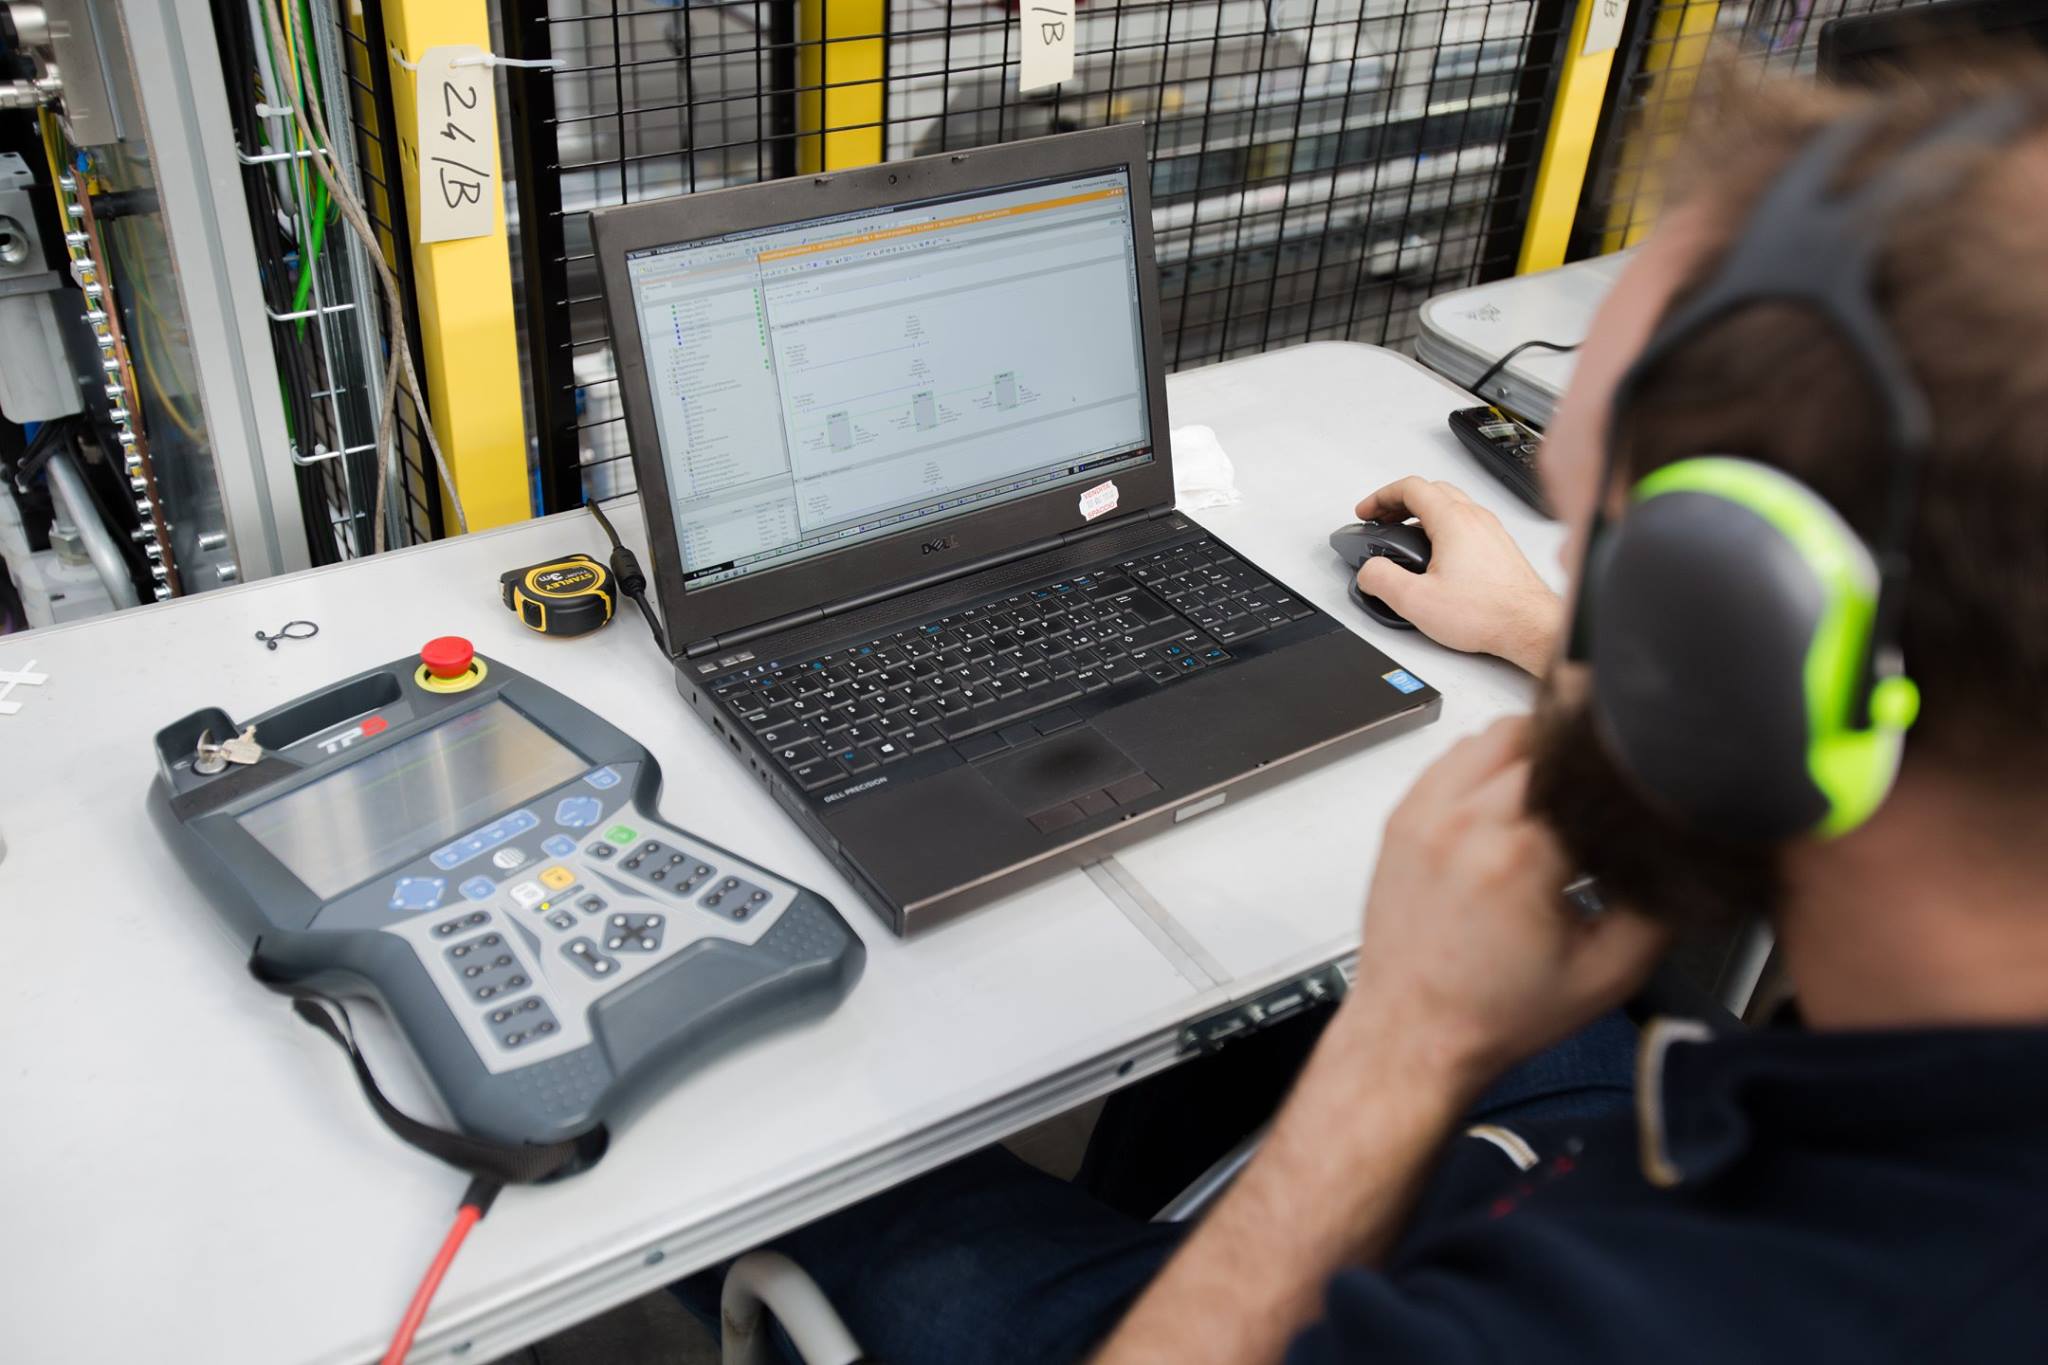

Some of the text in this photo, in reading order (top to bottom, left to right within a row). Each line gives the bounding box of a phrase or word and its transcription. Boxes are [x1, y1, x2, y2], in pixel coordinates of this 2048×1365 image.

[430, 81, 491, 209] 24/B
[545, 573, 593, 590] STANLEY
[823, 776, 888, 804] DELL PRECISION
